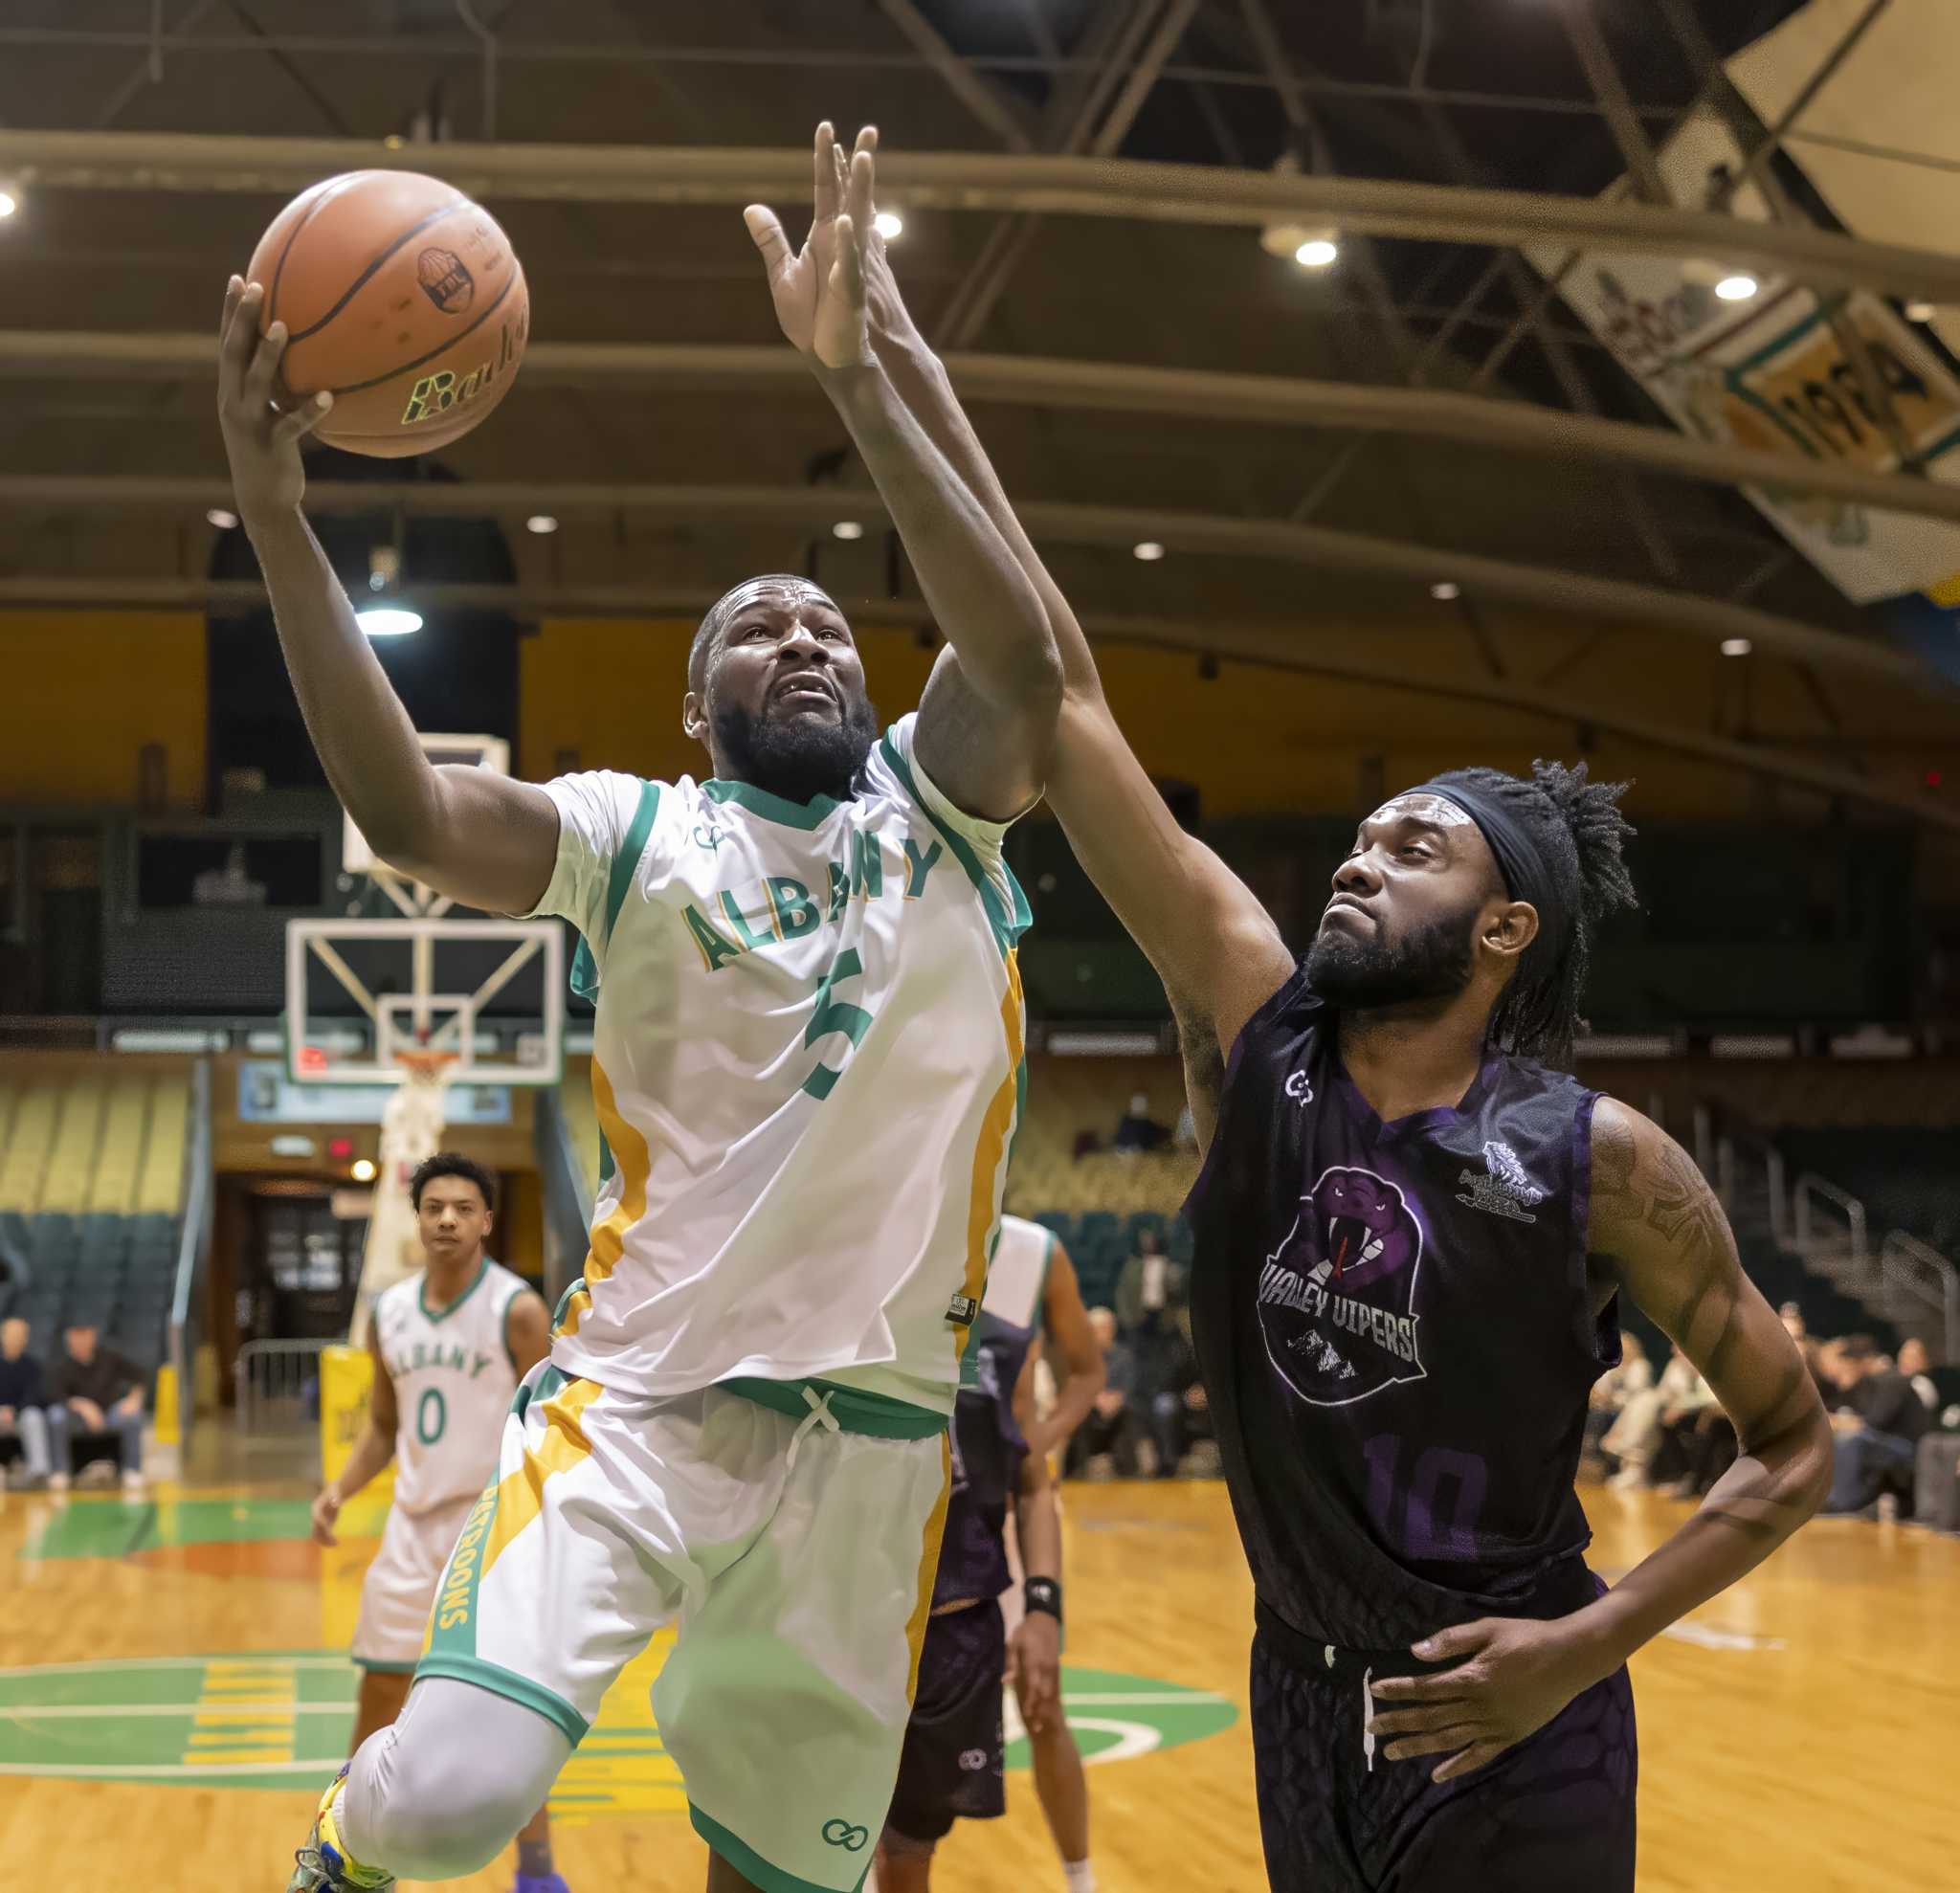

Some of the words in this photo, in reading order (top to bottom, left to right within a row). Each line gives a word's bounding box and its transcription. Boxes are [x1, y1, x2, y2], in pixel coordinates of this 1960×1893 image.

[680, 829, 943, 972] ALBANY
[804, 947, 873, 1101] 5
[1259, 1263, 1329, 1318] VALLEY
[1332, 1295, 1414, 1363] VIPERS
[418, 1387, 447, 1446] 0
[1363, 1433, 1487, 1562] 10
